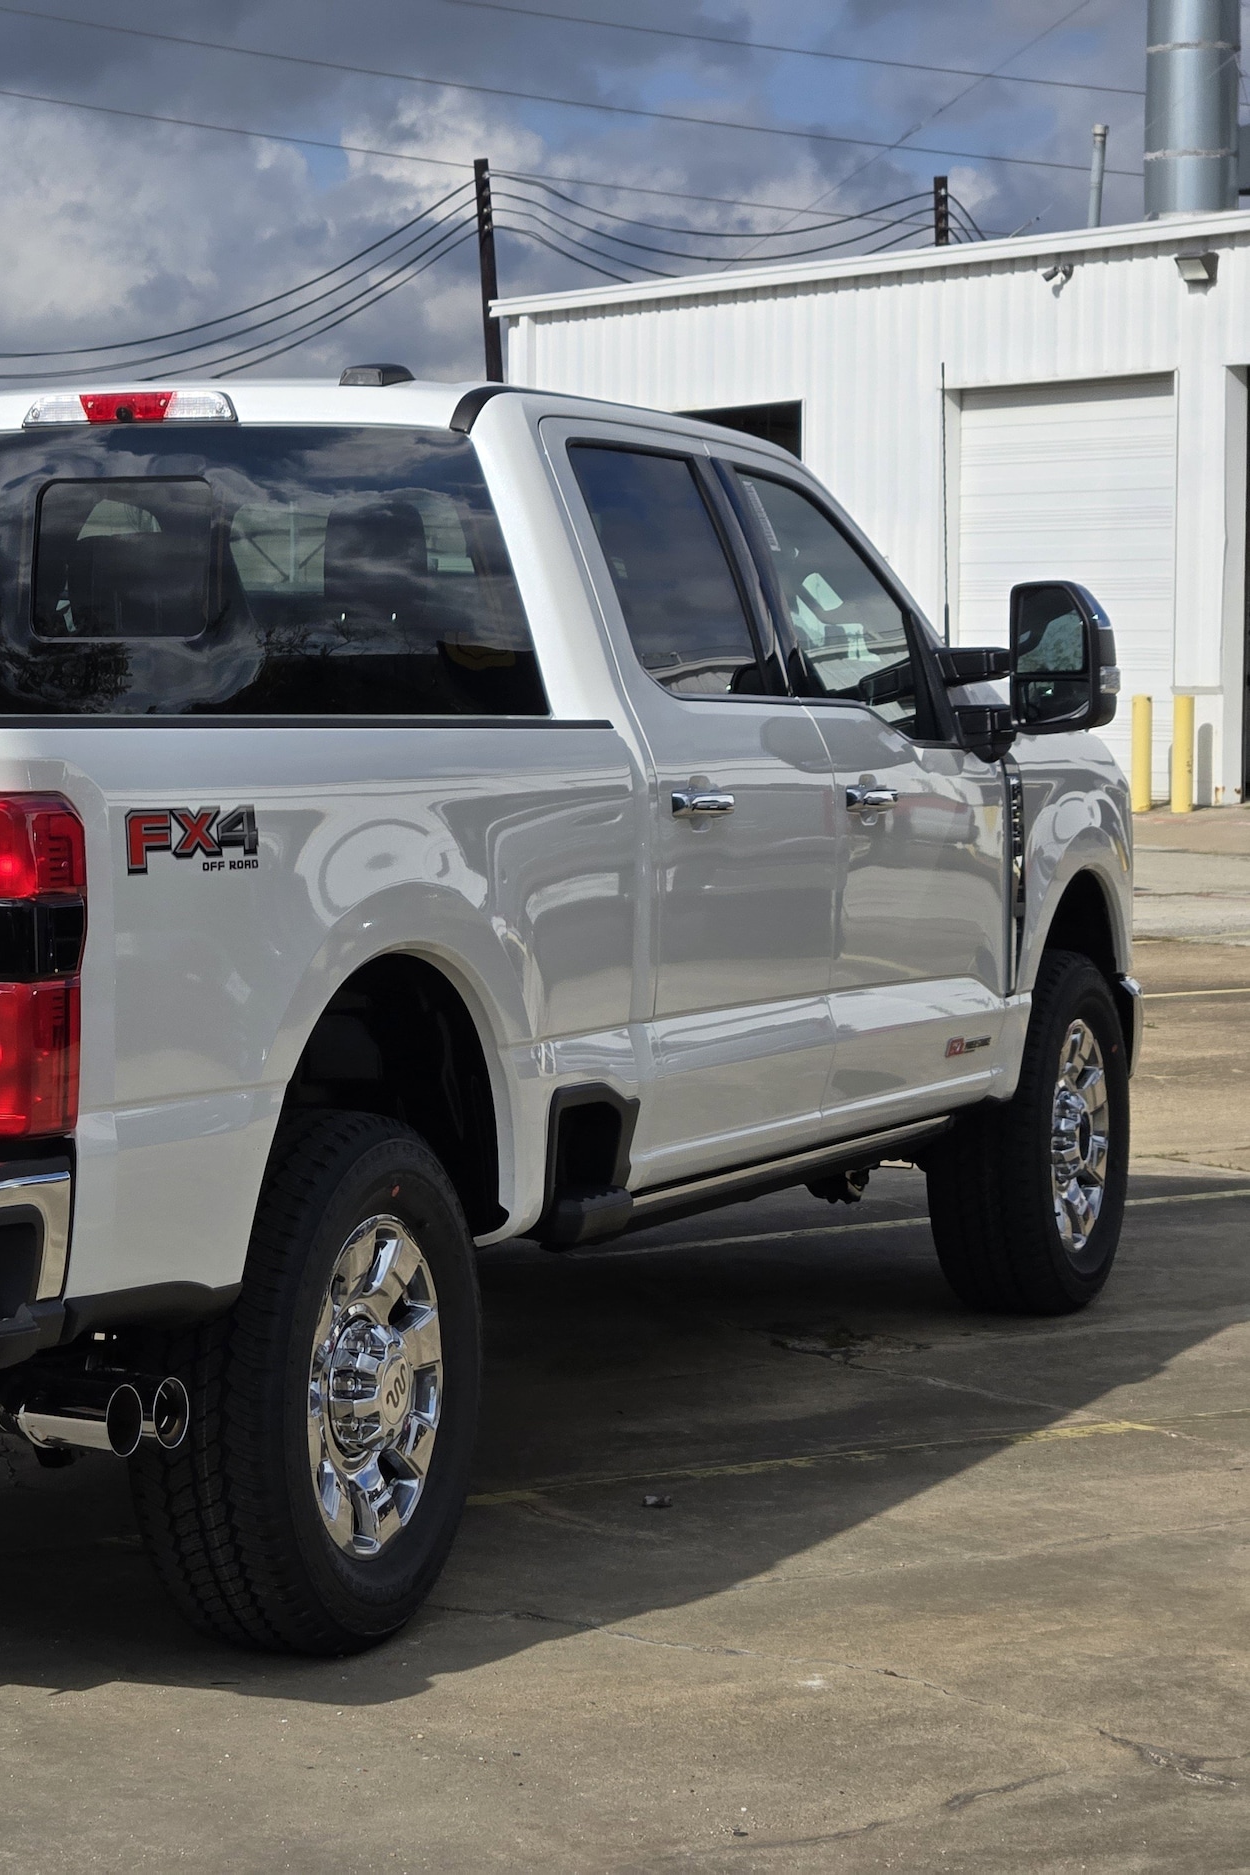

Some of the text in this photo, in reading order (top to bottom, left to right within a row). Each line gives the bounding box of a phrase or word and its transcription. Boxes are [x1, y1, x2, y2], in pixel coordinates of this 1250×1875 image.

[125, 804, 259, 876] FX4
[202, 859, 259, 871] OFF ROAD
